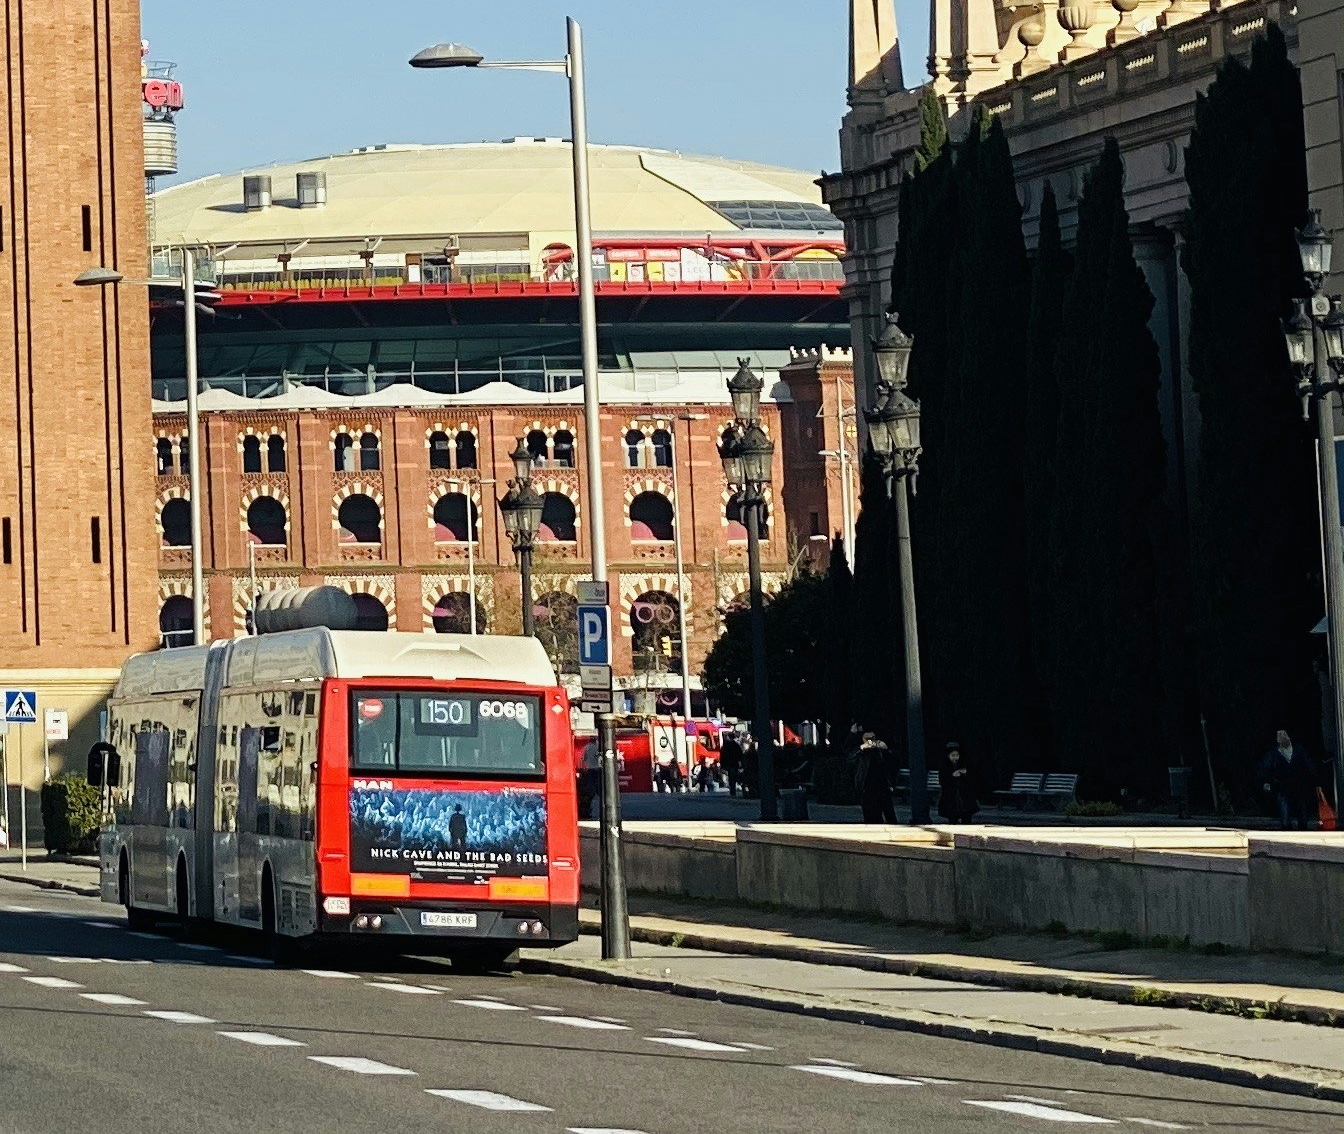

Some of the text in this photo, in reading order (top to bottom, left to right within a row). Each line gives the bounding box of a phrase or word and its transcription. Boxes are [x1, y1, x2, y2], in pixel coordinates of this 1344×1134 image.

[583, 612, 603, 658] P
[428, 700, 463, 724] 150
[479, 700, 529, 718] 6068
[353, 779, 394, 791] MAN
[371, 848, 548, 865] NICK CAVE AND THE BAD SEEDS
